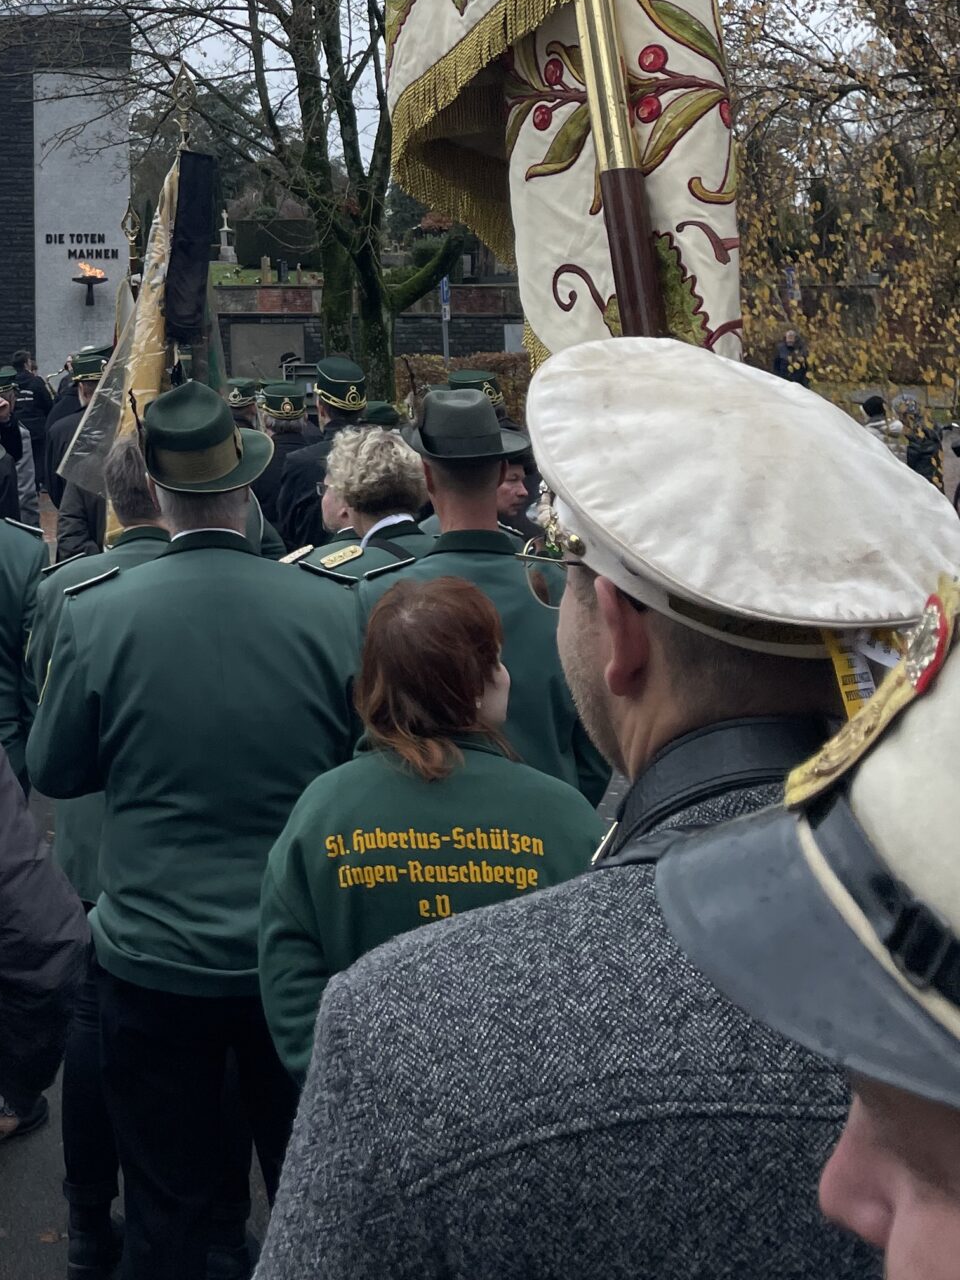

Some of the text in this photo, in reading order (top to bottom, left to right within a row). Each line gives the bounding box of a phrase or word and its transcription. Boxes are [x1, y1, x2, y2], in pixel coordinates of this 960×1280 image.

[45, 234, 105, 244] DIE TOTEN
[68, 249, 118, 259] MAHNEN
[325, 826, 544, 858] St. Hubertus-Schützen
[338, 860, 538, 890] Lingen-Reuschberge
